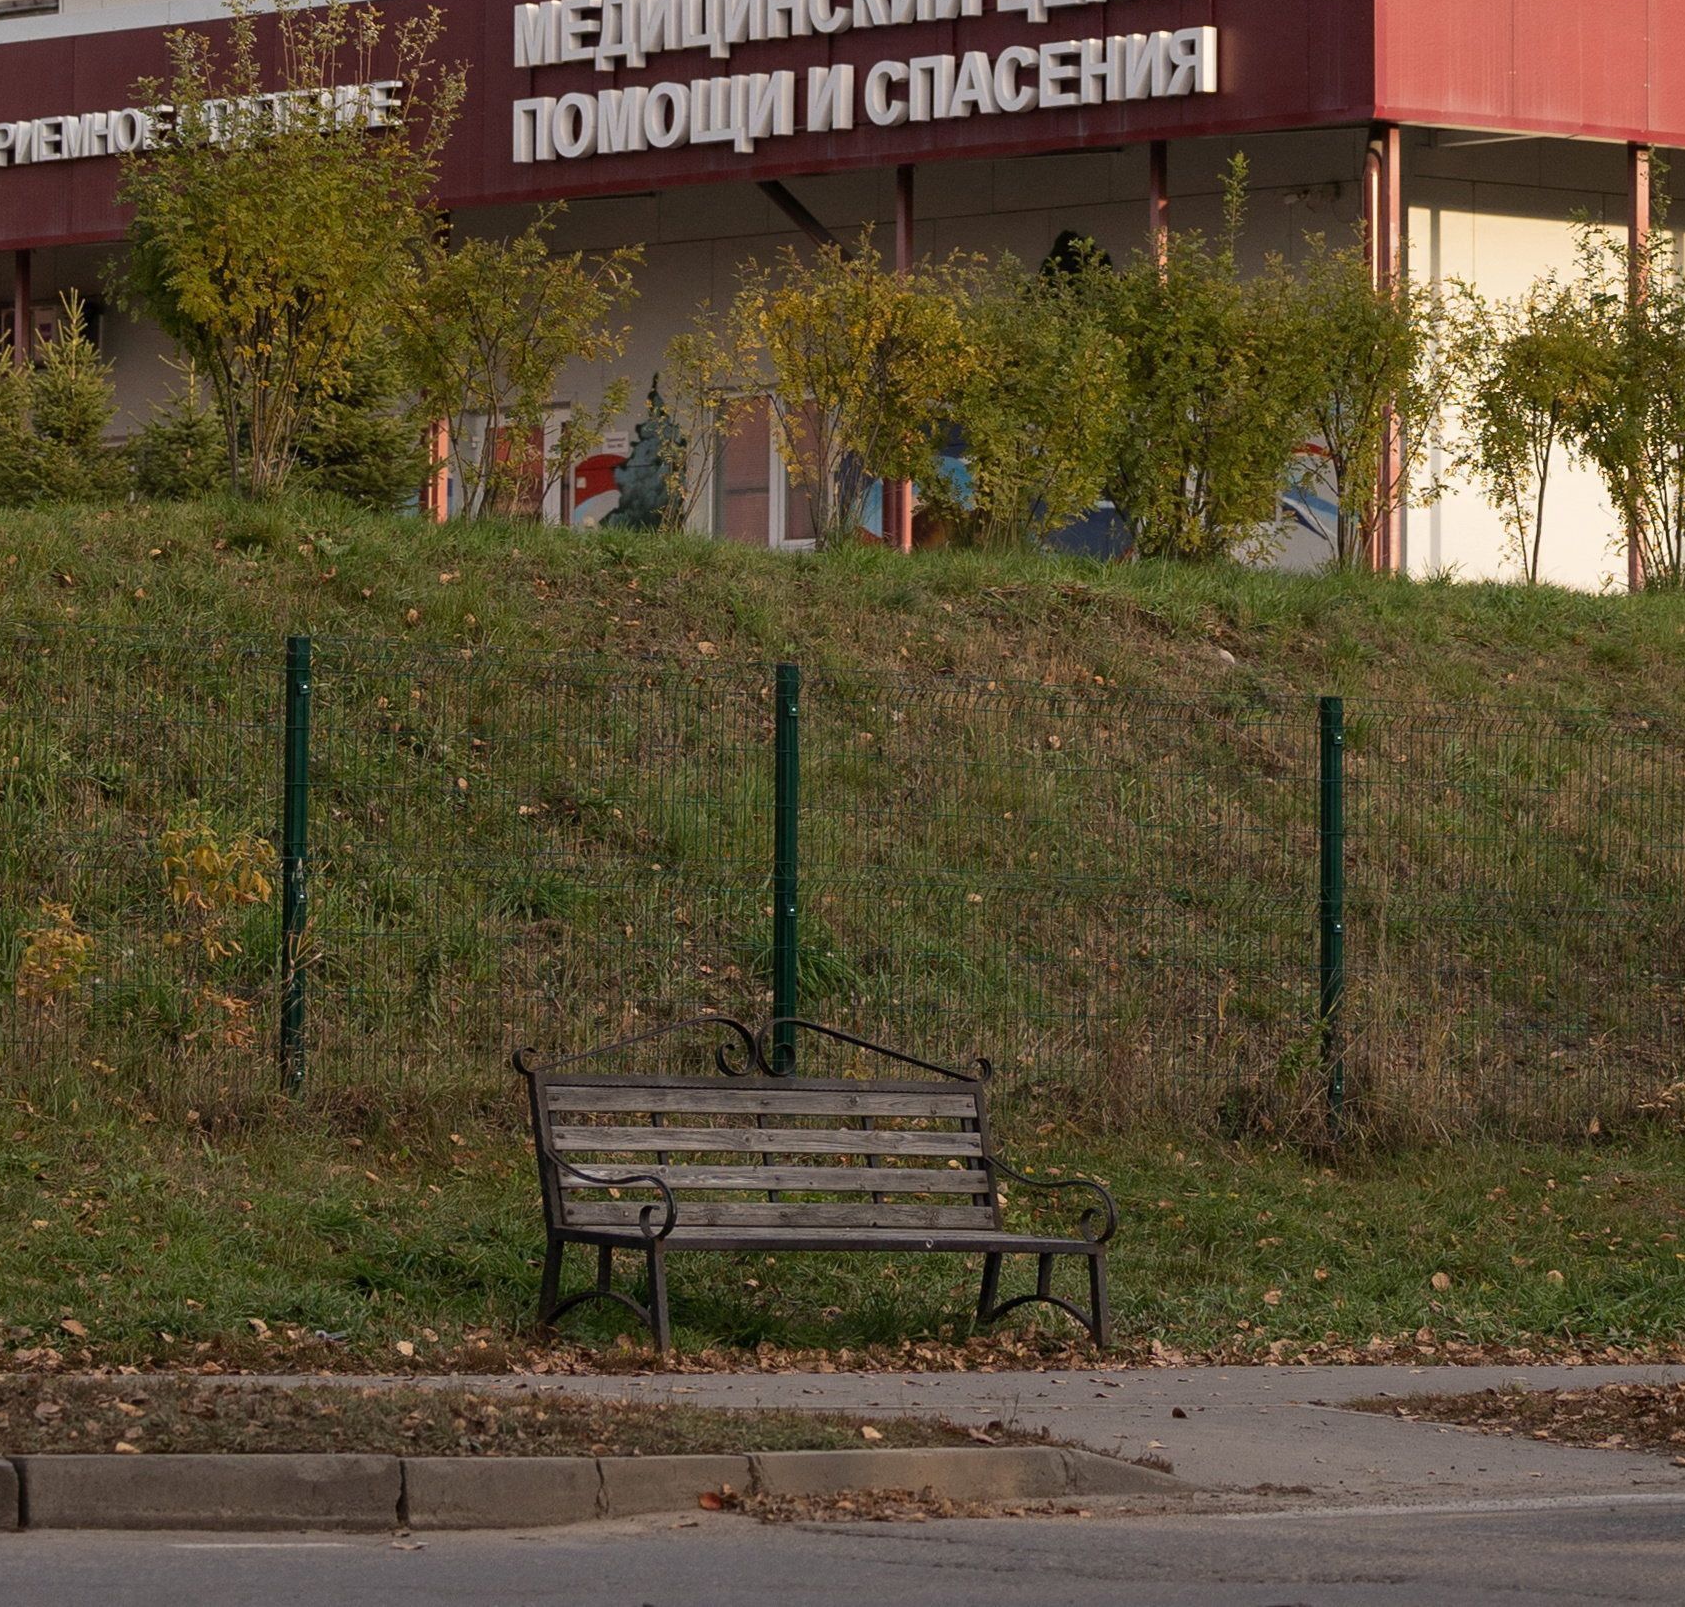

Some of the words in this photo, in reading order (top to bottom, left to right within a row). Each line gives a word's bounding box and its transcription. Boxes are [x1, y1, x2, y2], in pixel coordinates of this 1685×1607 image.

[513, 70, 795, 163] ПОМОЩИ
[807, 64, 854, 132] И
[865, 26, 1217, 126] СПАСЕНИЯ
